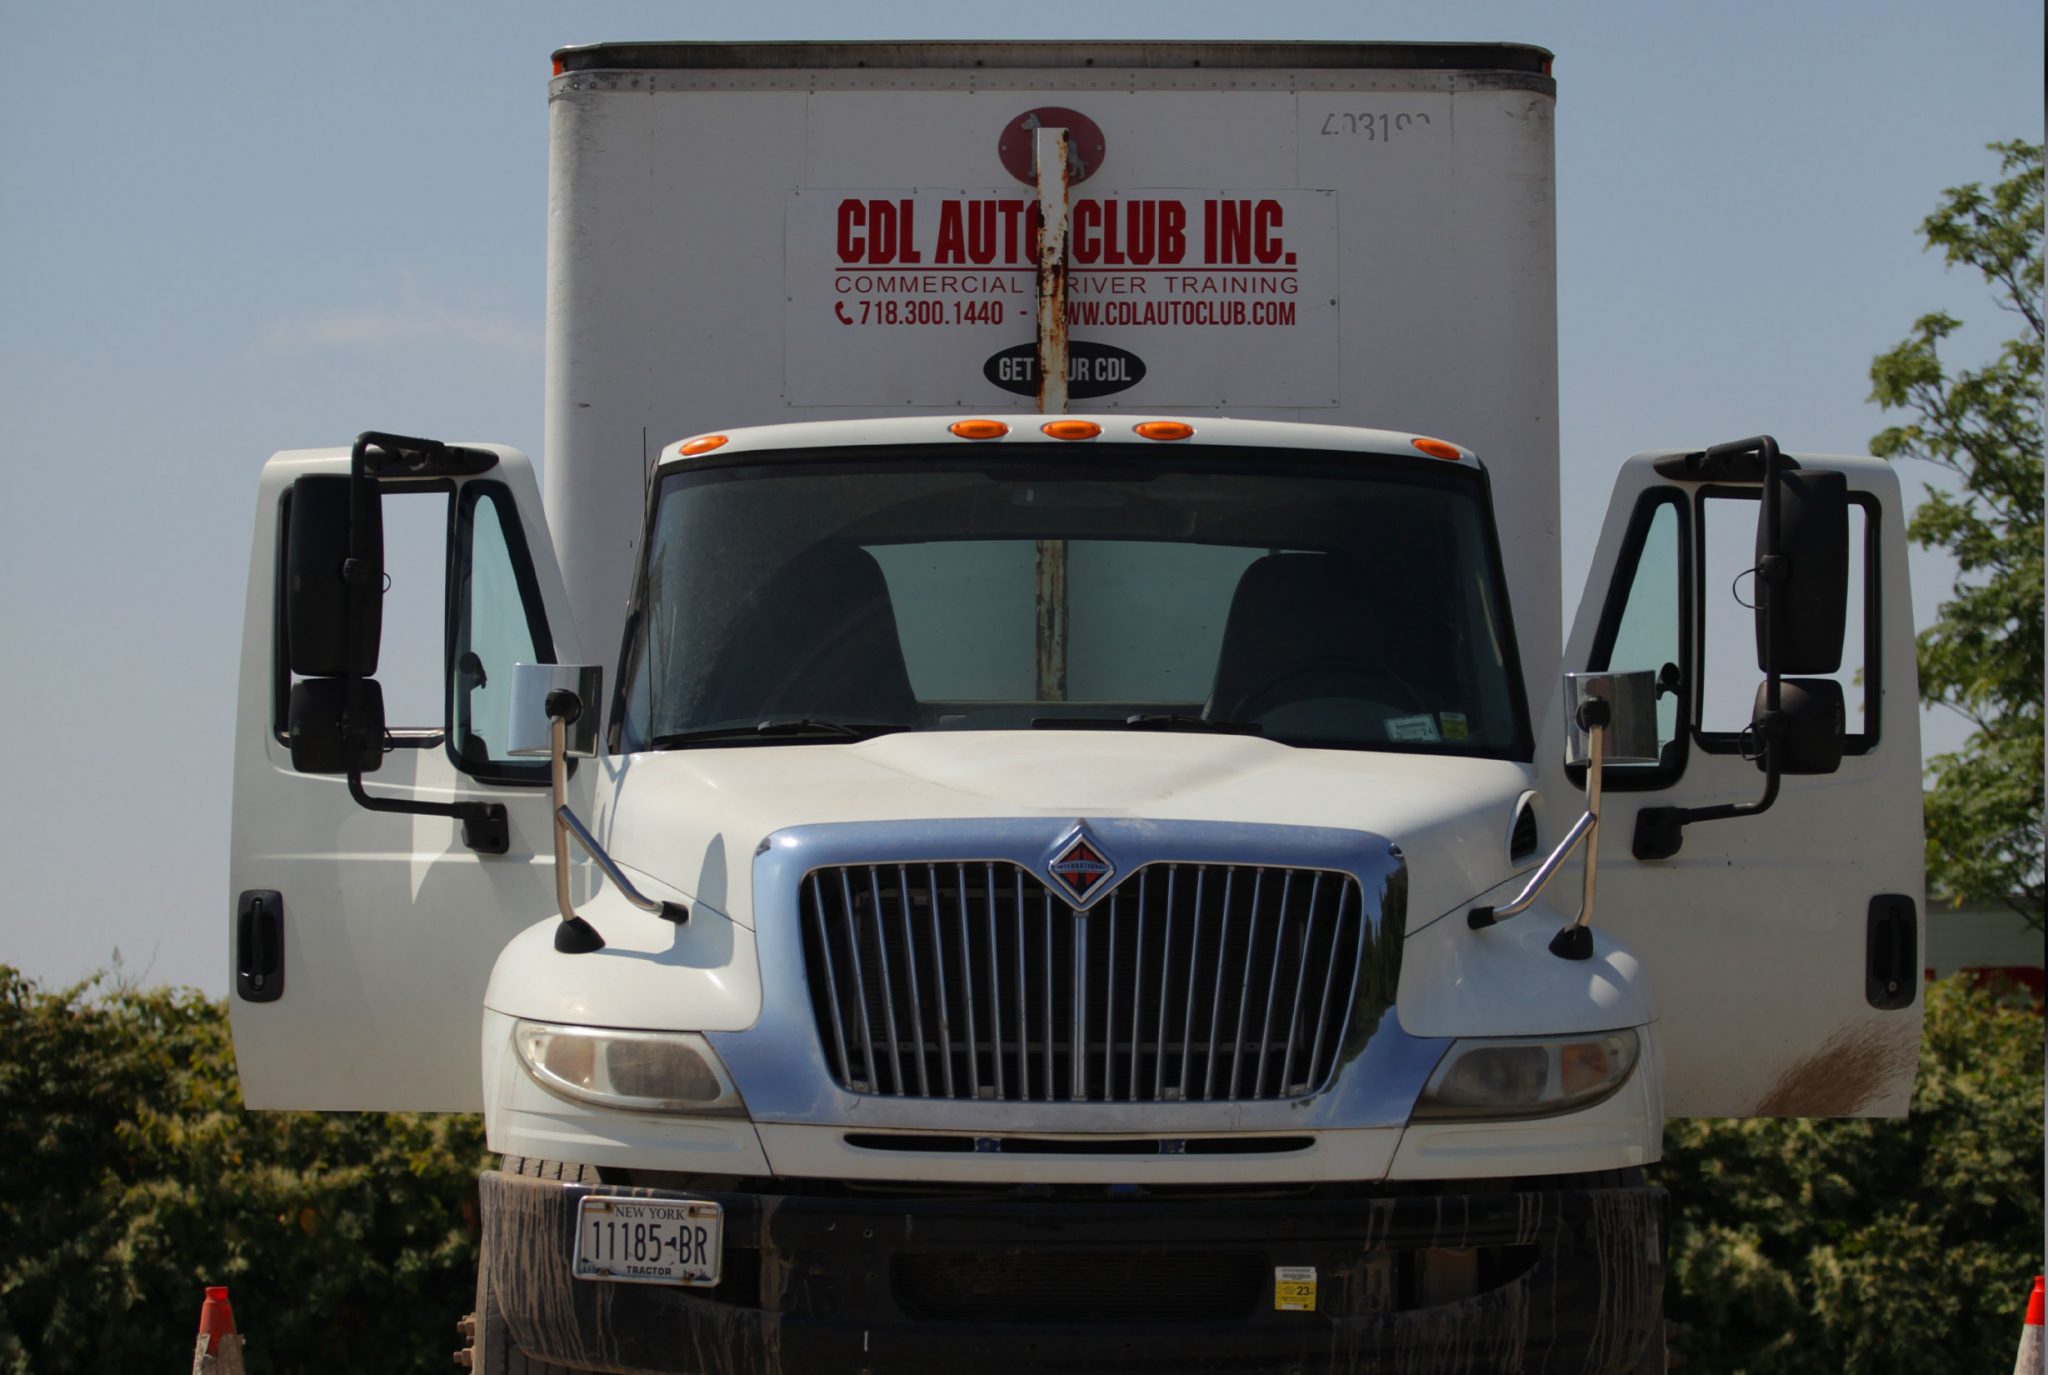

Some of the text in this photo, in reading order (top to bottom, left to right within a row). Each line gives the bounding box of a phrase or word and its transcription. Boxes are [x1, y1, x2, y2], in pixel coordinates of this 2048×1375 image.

[837, 199, 921, 264] CDL
[1073, 199, 1186, 264] CLUB
[1204, 199, 1297, 264] INC.
[835, 276, 1298, 295] COMMERCIAL RIVER TRAINING
[859, 300, 1003, 326] 718.300.1440
[1067, 301, 1296, 326] WW.CDLAUTOCLUB.COM
[999, 357, 1131, 381] GET UR CDL
[615, 1206, 686, 1221] NEW YORK
[627, 1265, 672, 1276] TRACTOR
[1296, 1286, 1310, 1296] 23
